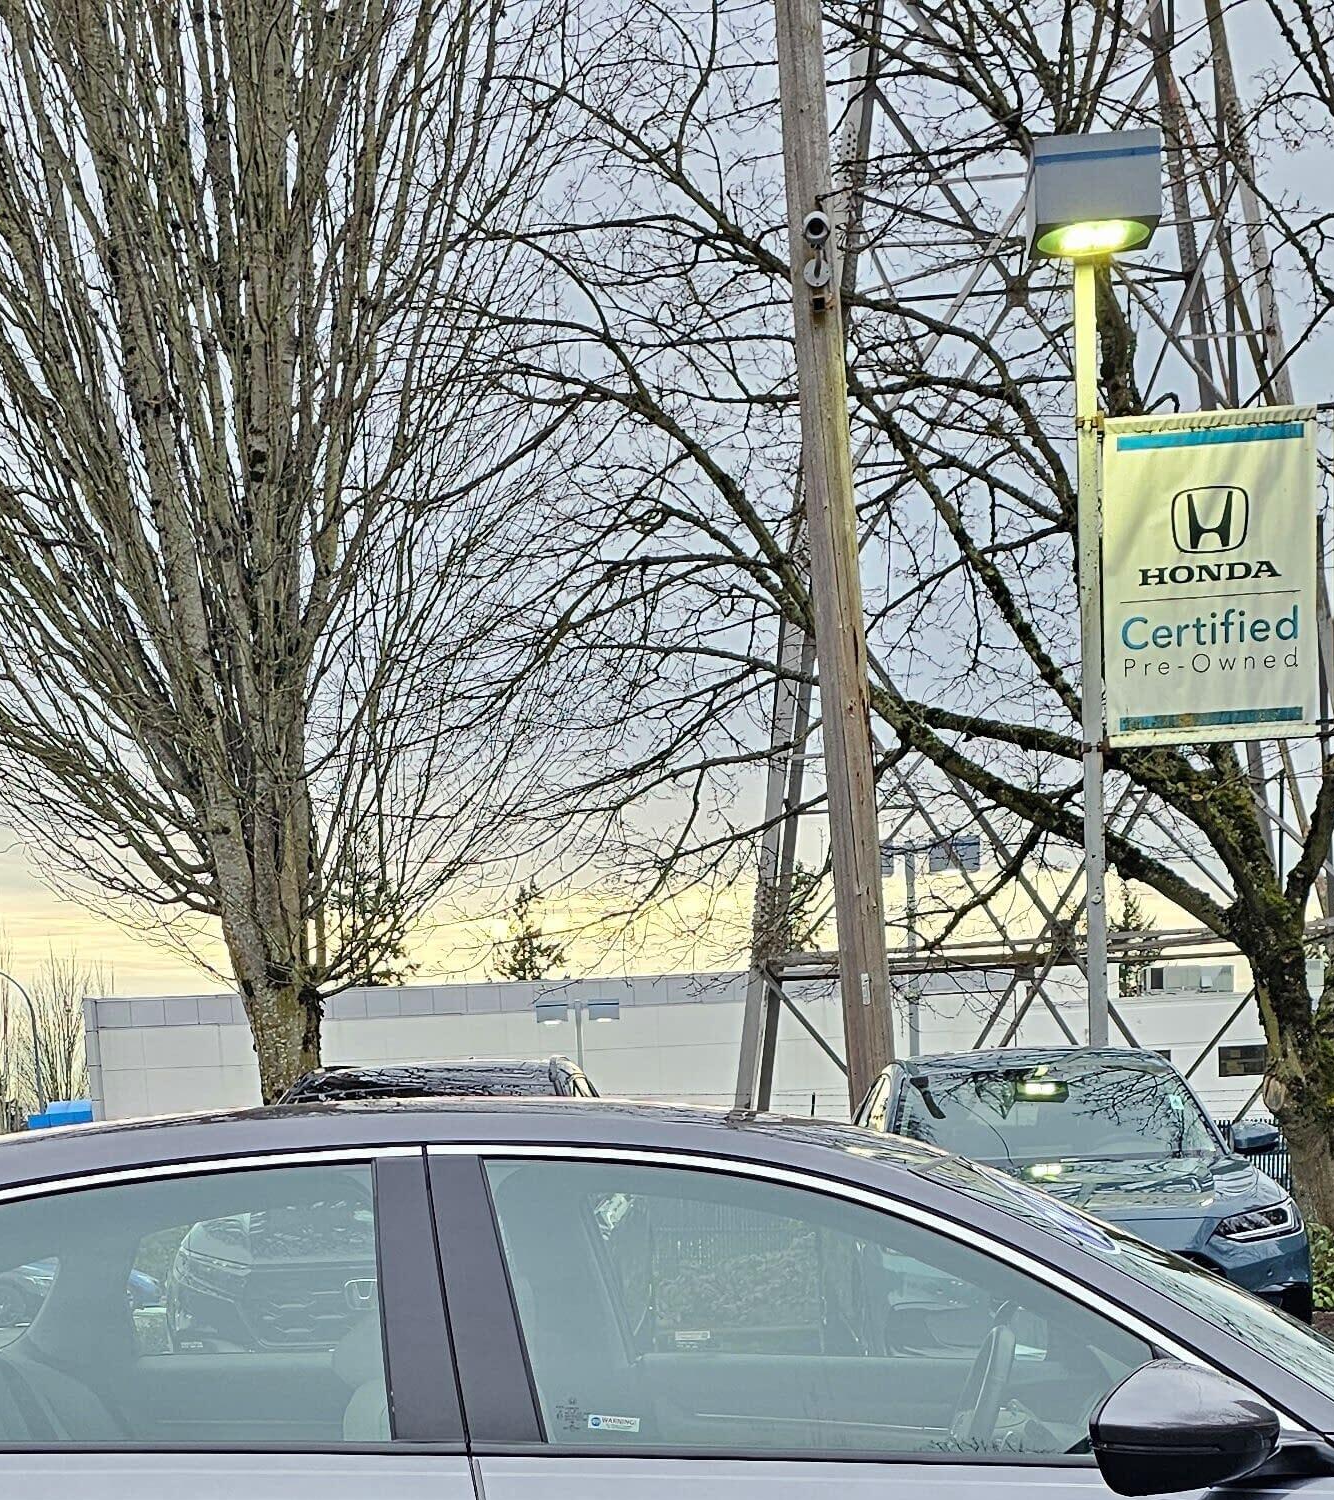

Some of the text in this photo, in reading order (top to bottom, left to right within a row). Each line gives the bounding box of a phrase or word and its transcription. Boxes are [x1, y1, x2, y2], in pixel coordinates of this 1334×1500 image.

[1138, 560, 1282, 586] HONDA
[1120, 604, 1299, 651] Certified
[1124, 646, 1299, 678] Pre-Owned
